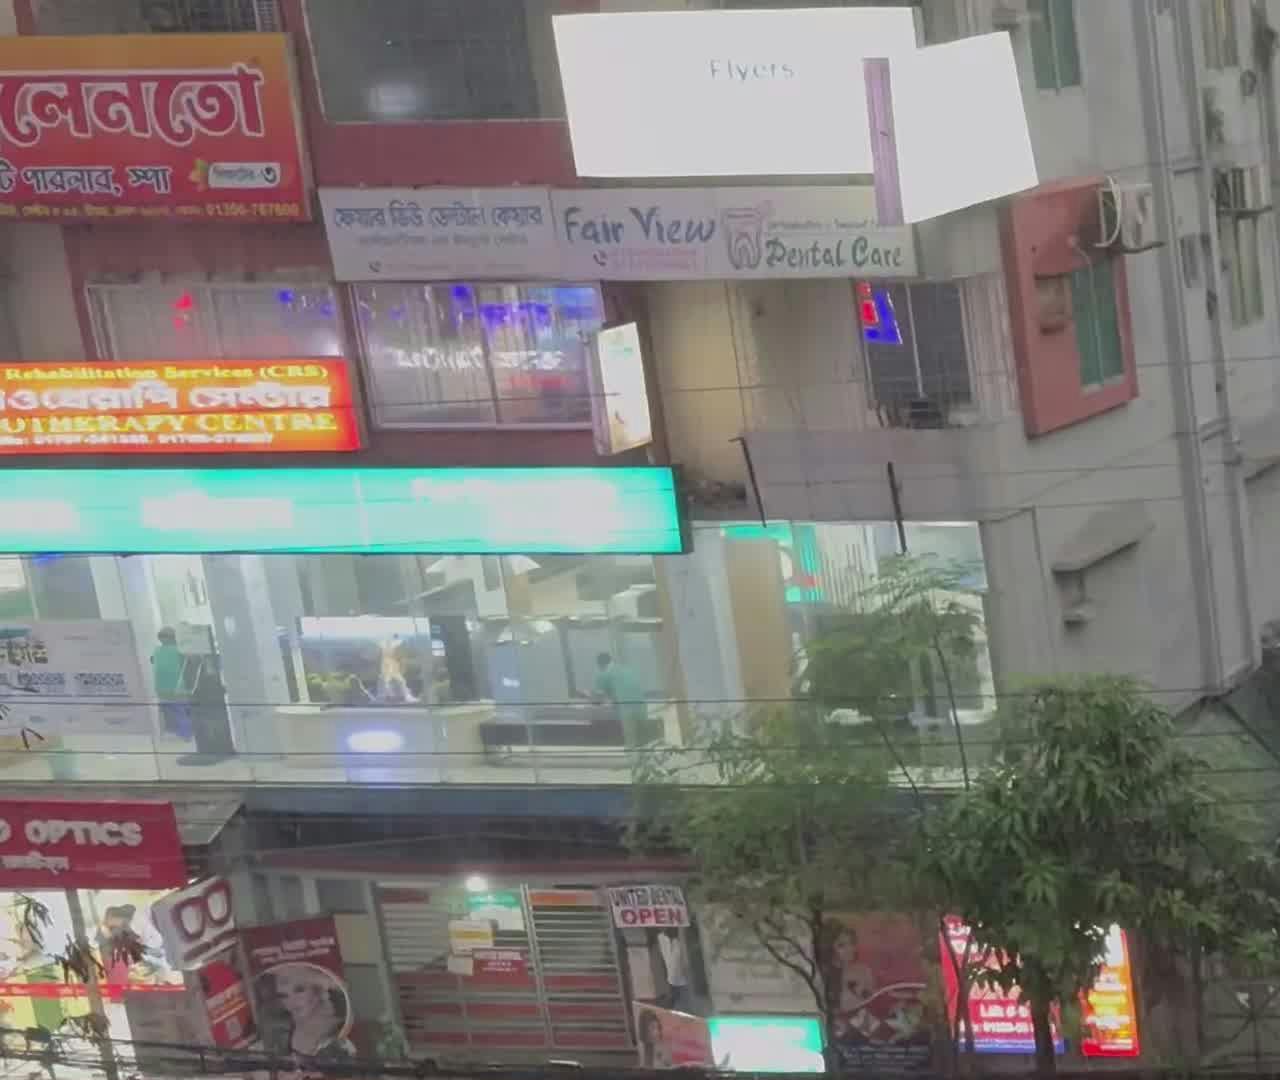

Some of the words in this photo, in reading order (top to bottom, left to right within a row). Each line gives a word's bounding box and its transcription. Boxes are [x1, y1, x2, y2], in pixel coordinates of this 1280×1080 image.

[563, 206, 625, 244] Fair
[629, 206, 716, 245] View
[765, 236, 846, 268] Dental
[851, 235, 904, 268] Care
[25, 819, 143, 847] OPTICS
[622, 907, 682, 925] OPEN
